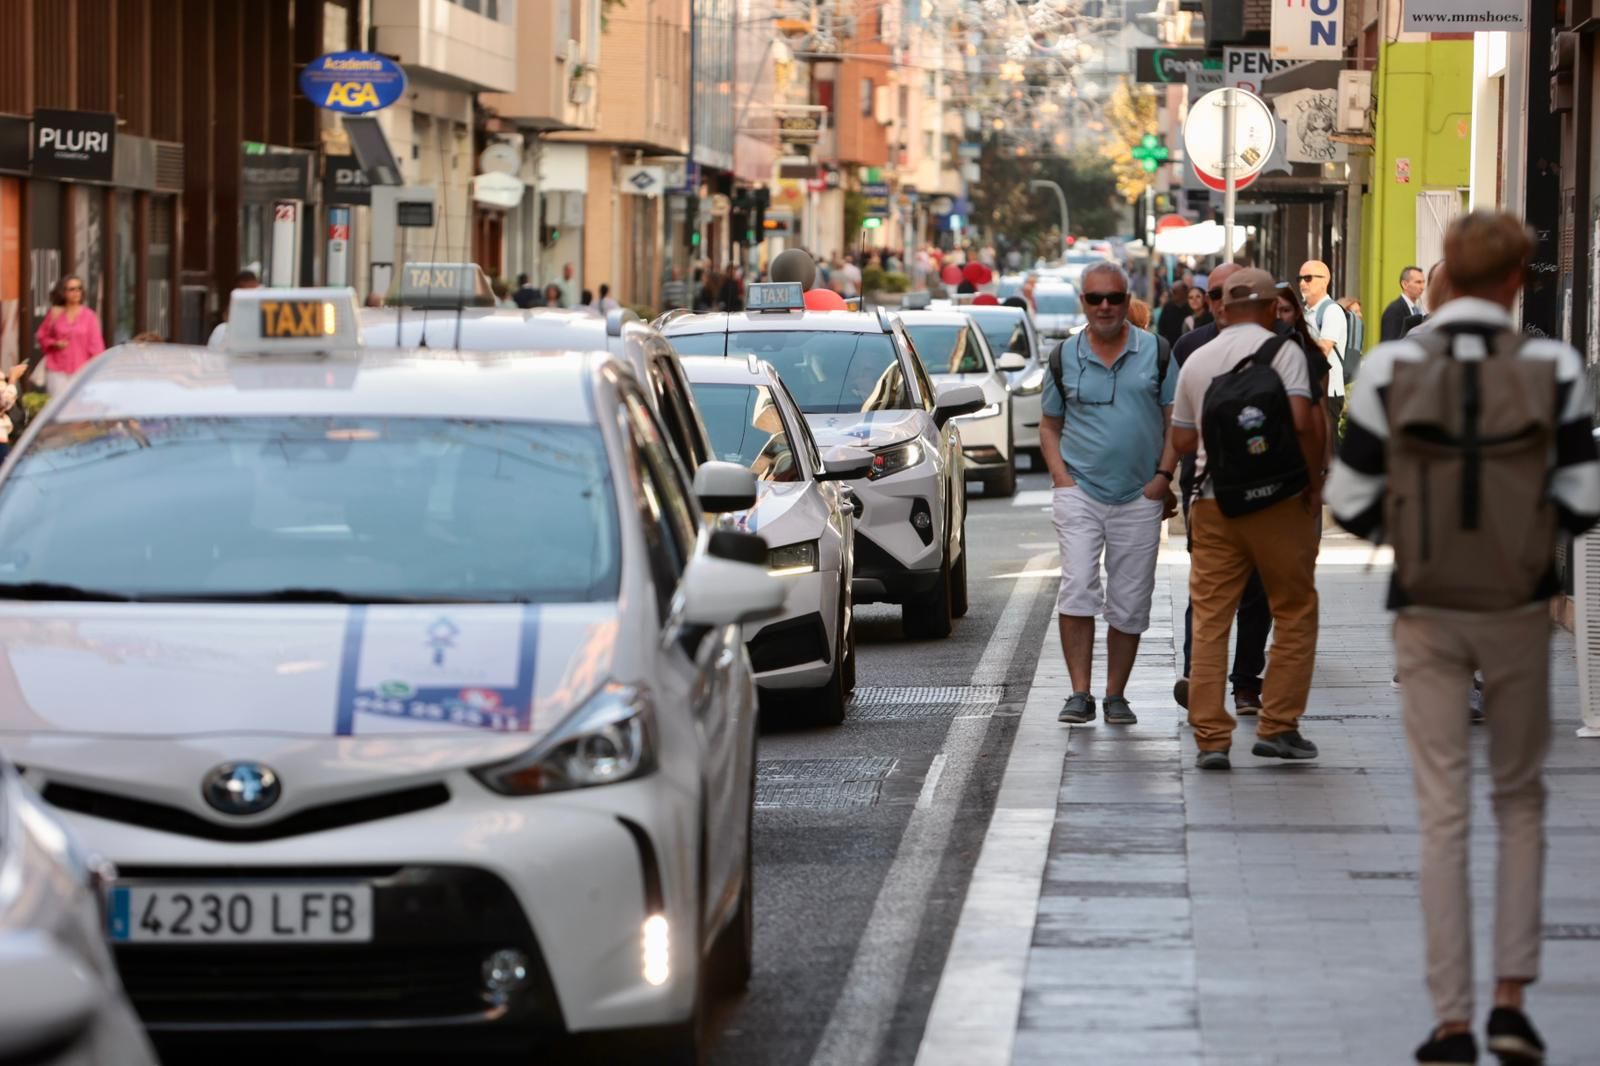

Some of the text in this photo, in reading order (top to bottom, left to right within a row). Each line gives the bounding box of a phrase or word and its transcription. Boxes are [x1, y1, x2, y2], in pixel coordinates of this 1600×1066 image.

[325, 82, 380, 107] AGA
[39, 127, 108, 152] PLURI
[410, 269, 455, 288] TAXI
[761, 288, 789, 303] TAXI
[261, 303, 323, 336] TAXI
[140, 893, 254, 934] 4230
[272, 893, 355, 934] LFB
